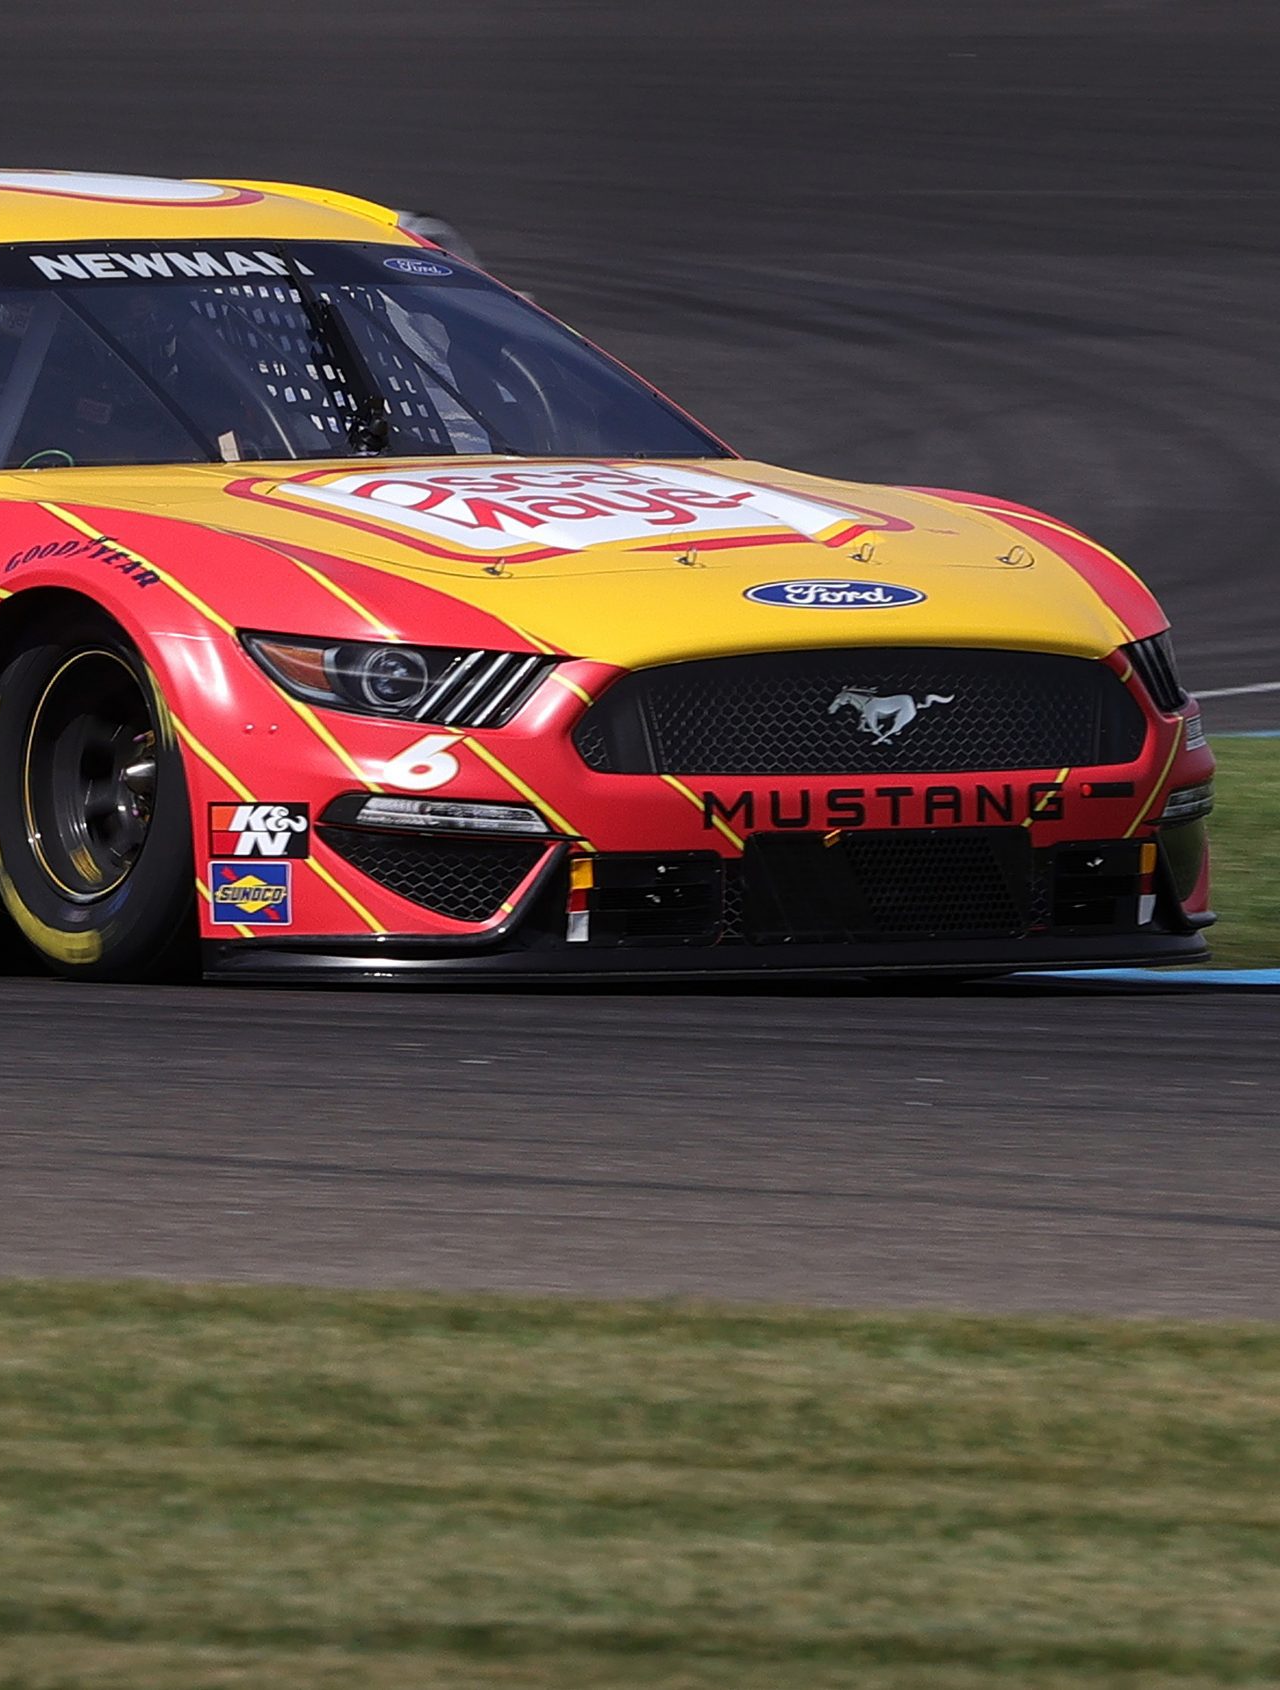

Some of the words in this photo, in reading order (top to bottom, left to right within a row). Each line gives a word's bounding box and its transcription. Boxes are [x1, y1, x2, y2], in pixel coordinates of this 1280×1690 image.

[28, 250, 316, 281] NEWMAN
[397, 259, 442, 274] Ford
[351, 471, 662, 512] Osca
[783, 583, 893, 604] Ford
[383, 733, 467, 791] 6
[702, 782, 1064, 830] MUSTANG
[219, 886, 284, 902] SUNOCO
